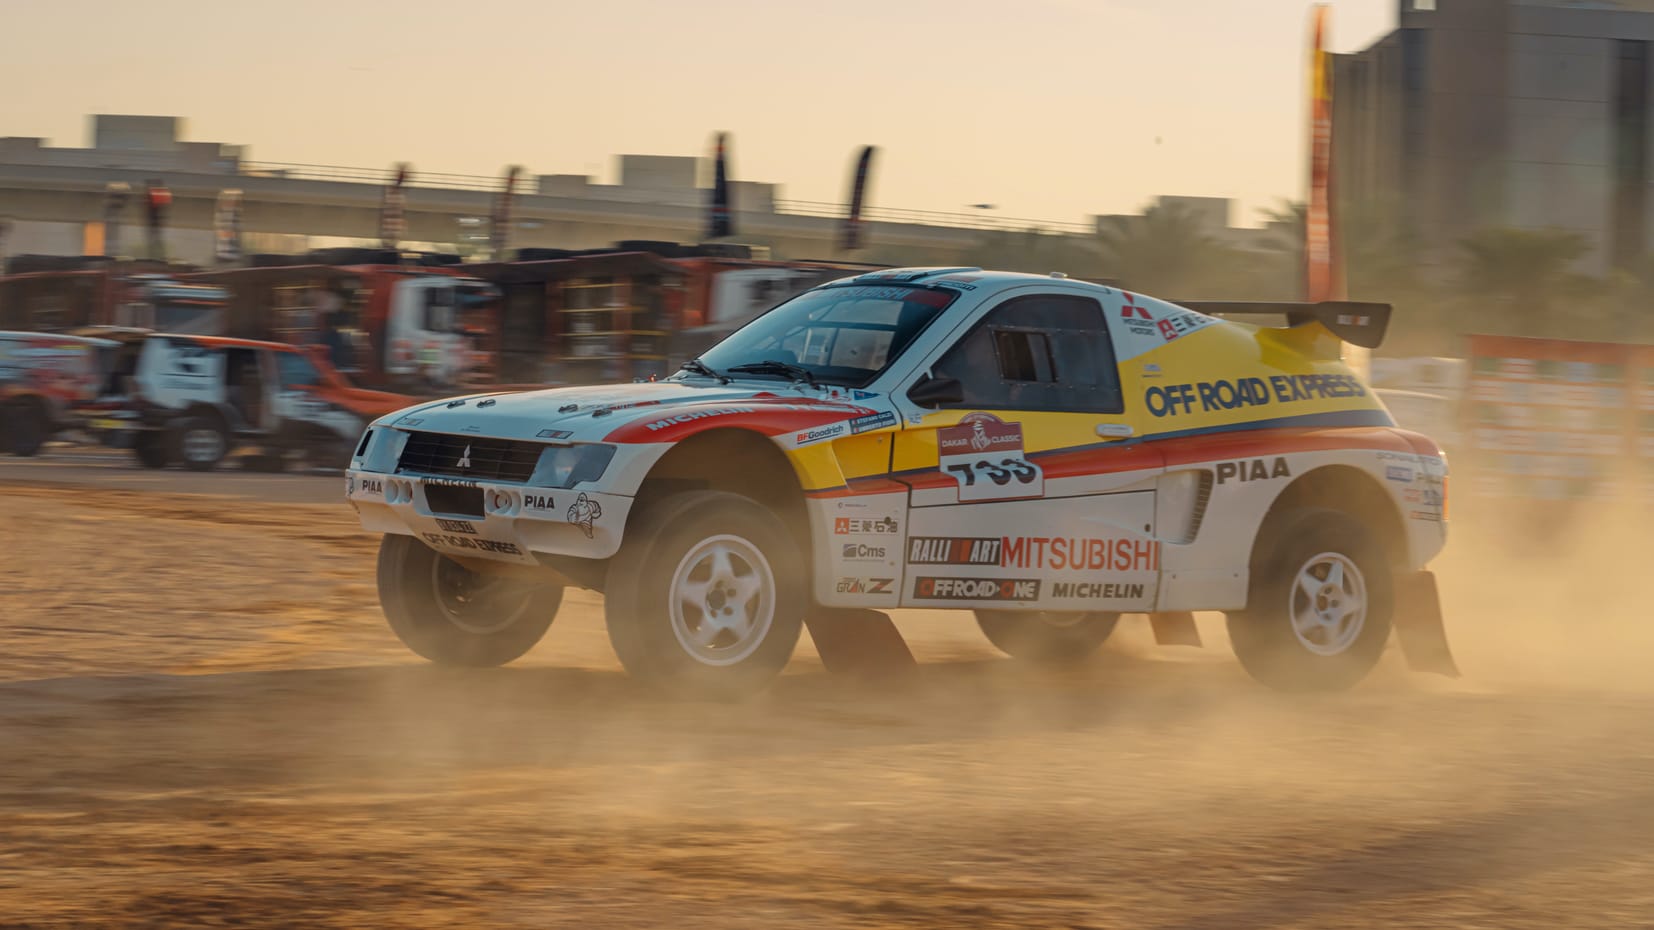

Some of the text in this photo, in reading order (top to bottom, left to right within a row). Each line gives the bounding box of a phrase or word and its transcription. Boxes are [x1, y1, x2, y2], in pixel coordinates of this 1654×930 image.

[1145, 374, 1367, 417] OFF ROAD EXPRESS
[647, 406, 754, 431] MICHELIN
[797, 424, 843, 442] BFGoodrich
[942, 434, 1021, 448] DAKAR CLASSIC
[947, 458, 1036, 486] 733
[1216, 457, 1291, 485] PIAA
[362, 480, 382, 493] PIAA
[524, 495, 555, 509] PIAA
[858, 544, 885, 558] Cms
[1000, 536, 1160, 571] MITSUBISHI
[1052, 583, 1144, 599] MICHELIN
